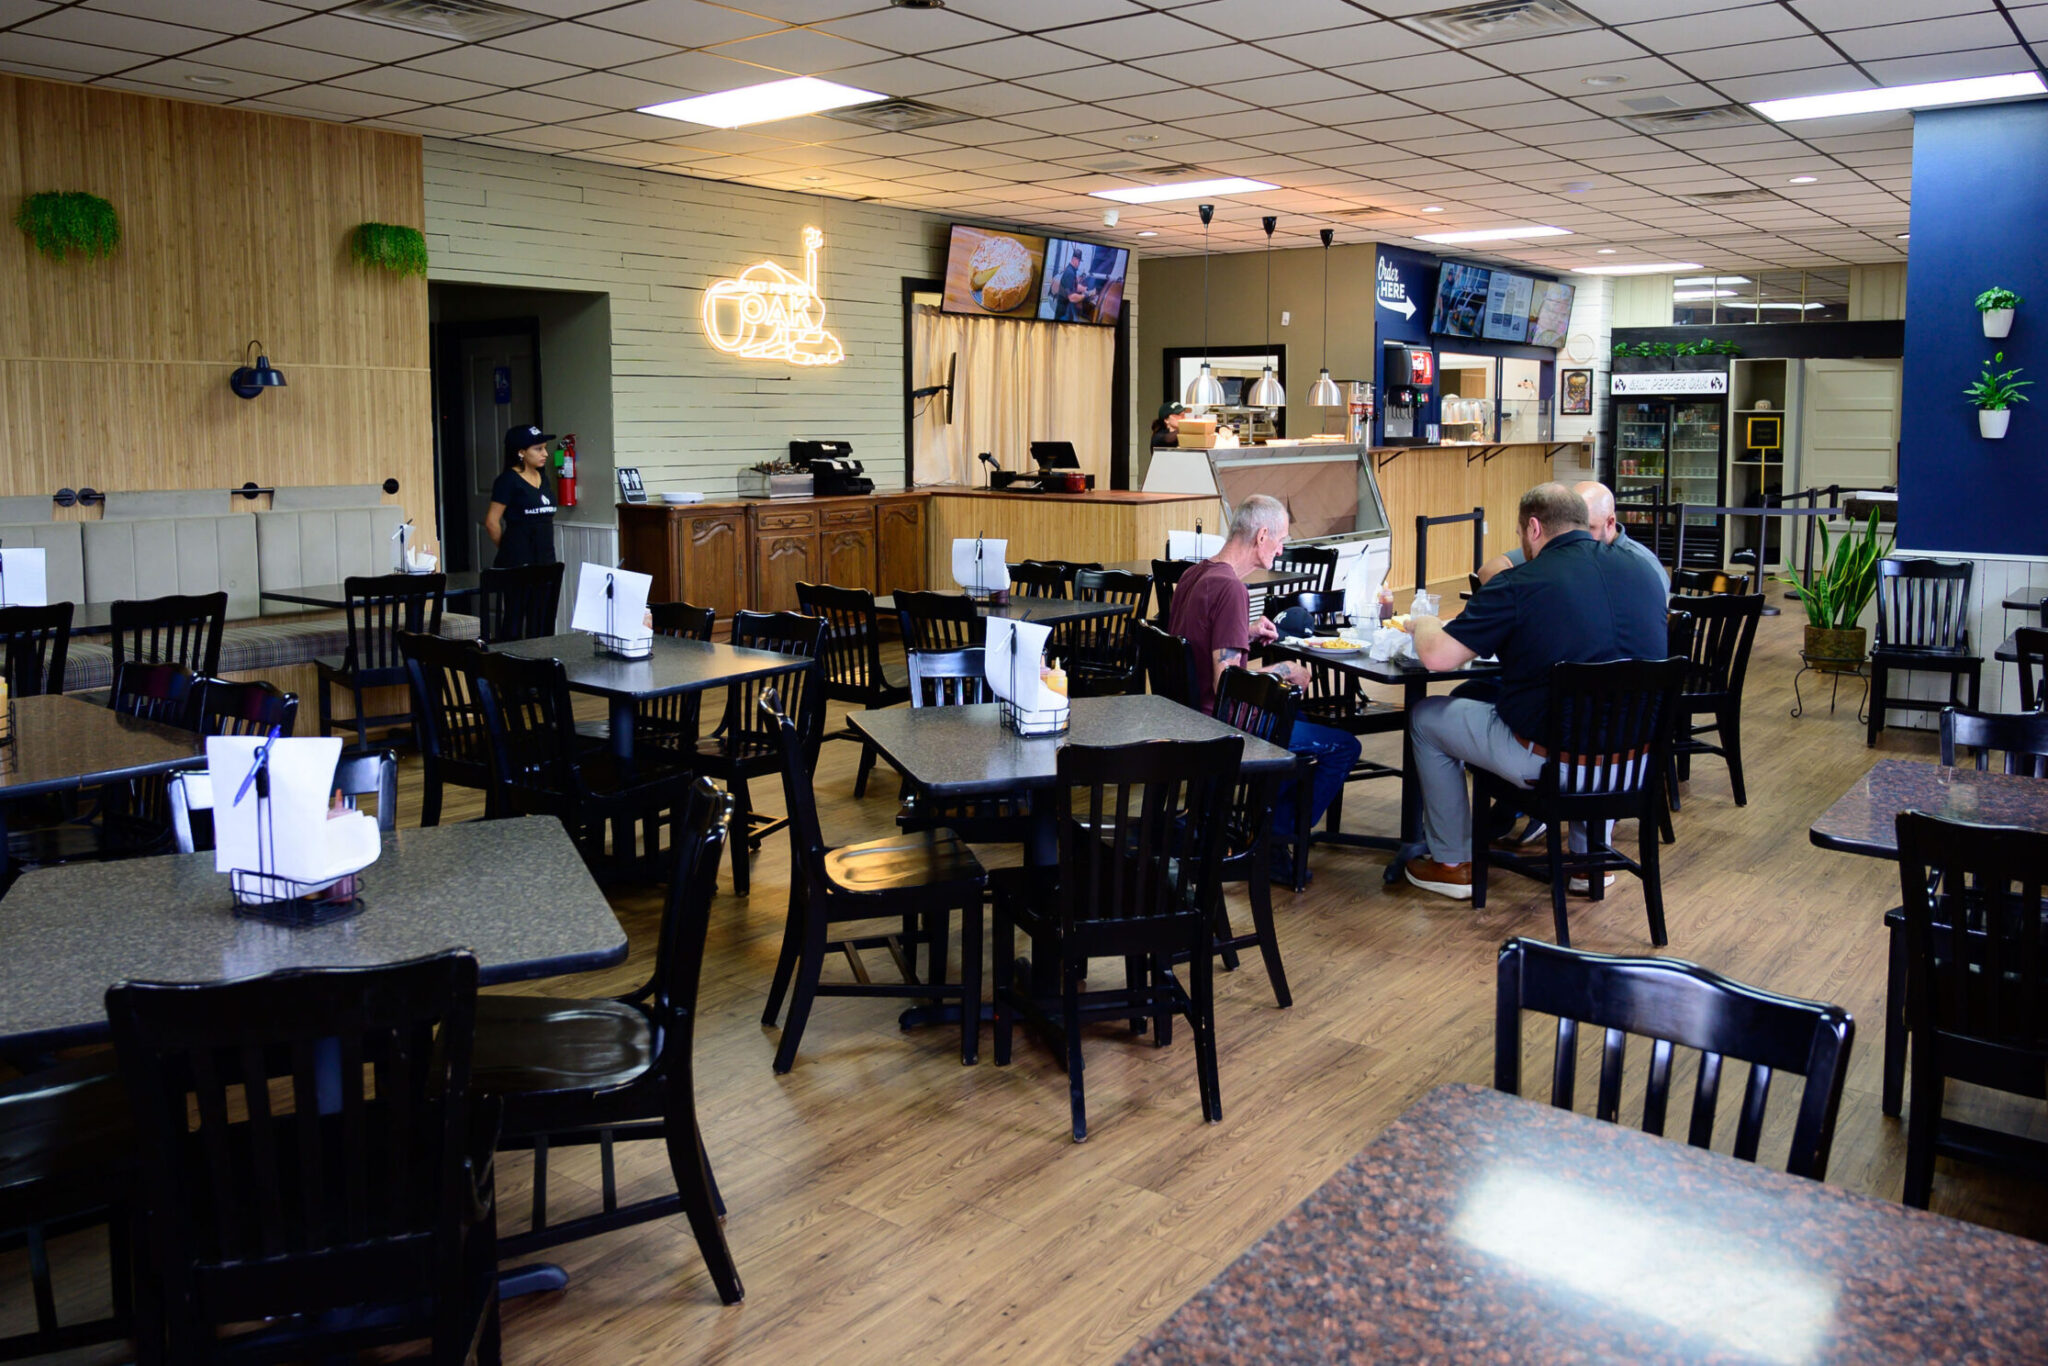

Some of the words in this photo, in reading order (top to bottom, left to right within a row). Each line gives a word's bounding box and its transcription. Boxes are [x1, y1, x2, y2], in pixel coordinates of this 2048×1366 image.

[1378, 255, 1399, 281] Order
[1380, 281, 1405, 299] HERE
[740, 292, 816, 328] OAK
